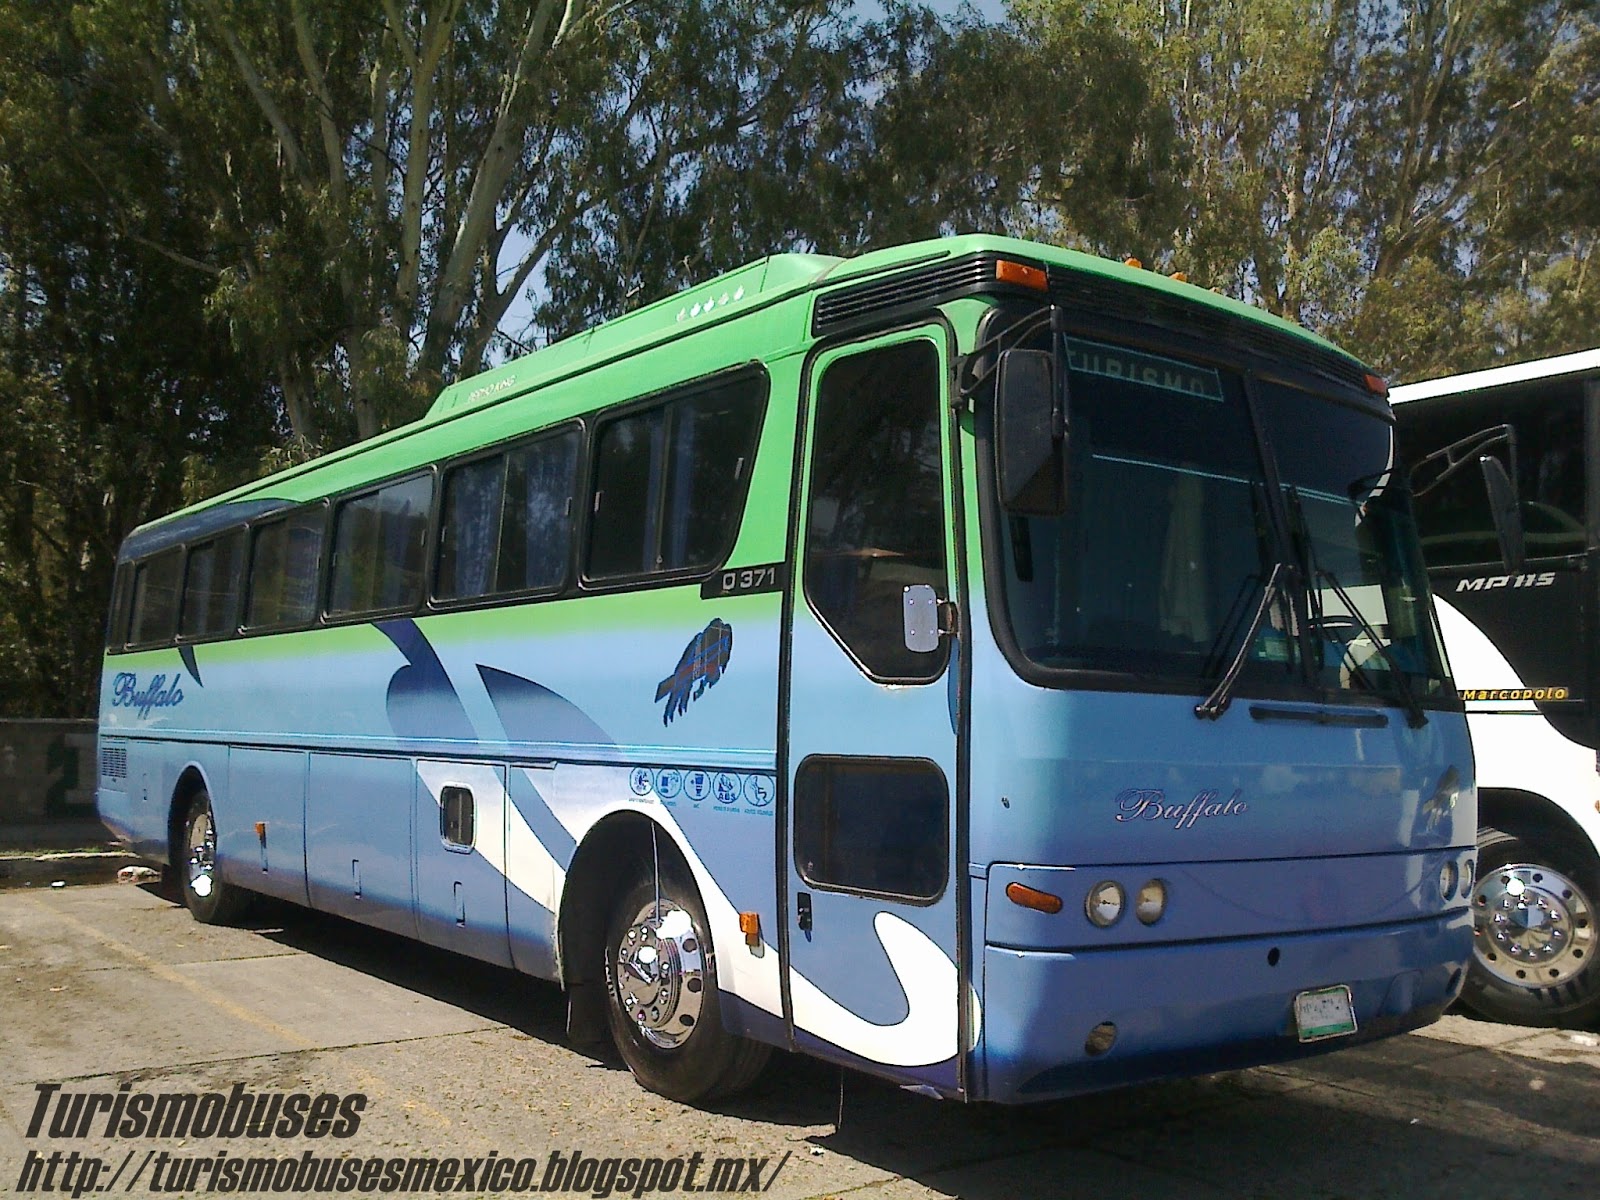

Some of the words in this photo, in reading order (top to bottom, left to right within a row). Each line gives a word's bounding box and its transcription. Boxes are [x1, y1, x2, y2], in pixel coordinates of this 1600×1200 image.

[1456, 575, 1510, 592] MP
[112, 672, 184, 720] Buffalo
[1463, 687, 1566, 700] Marcopolo
[1115, 788, 1248, 829] Buffalo
